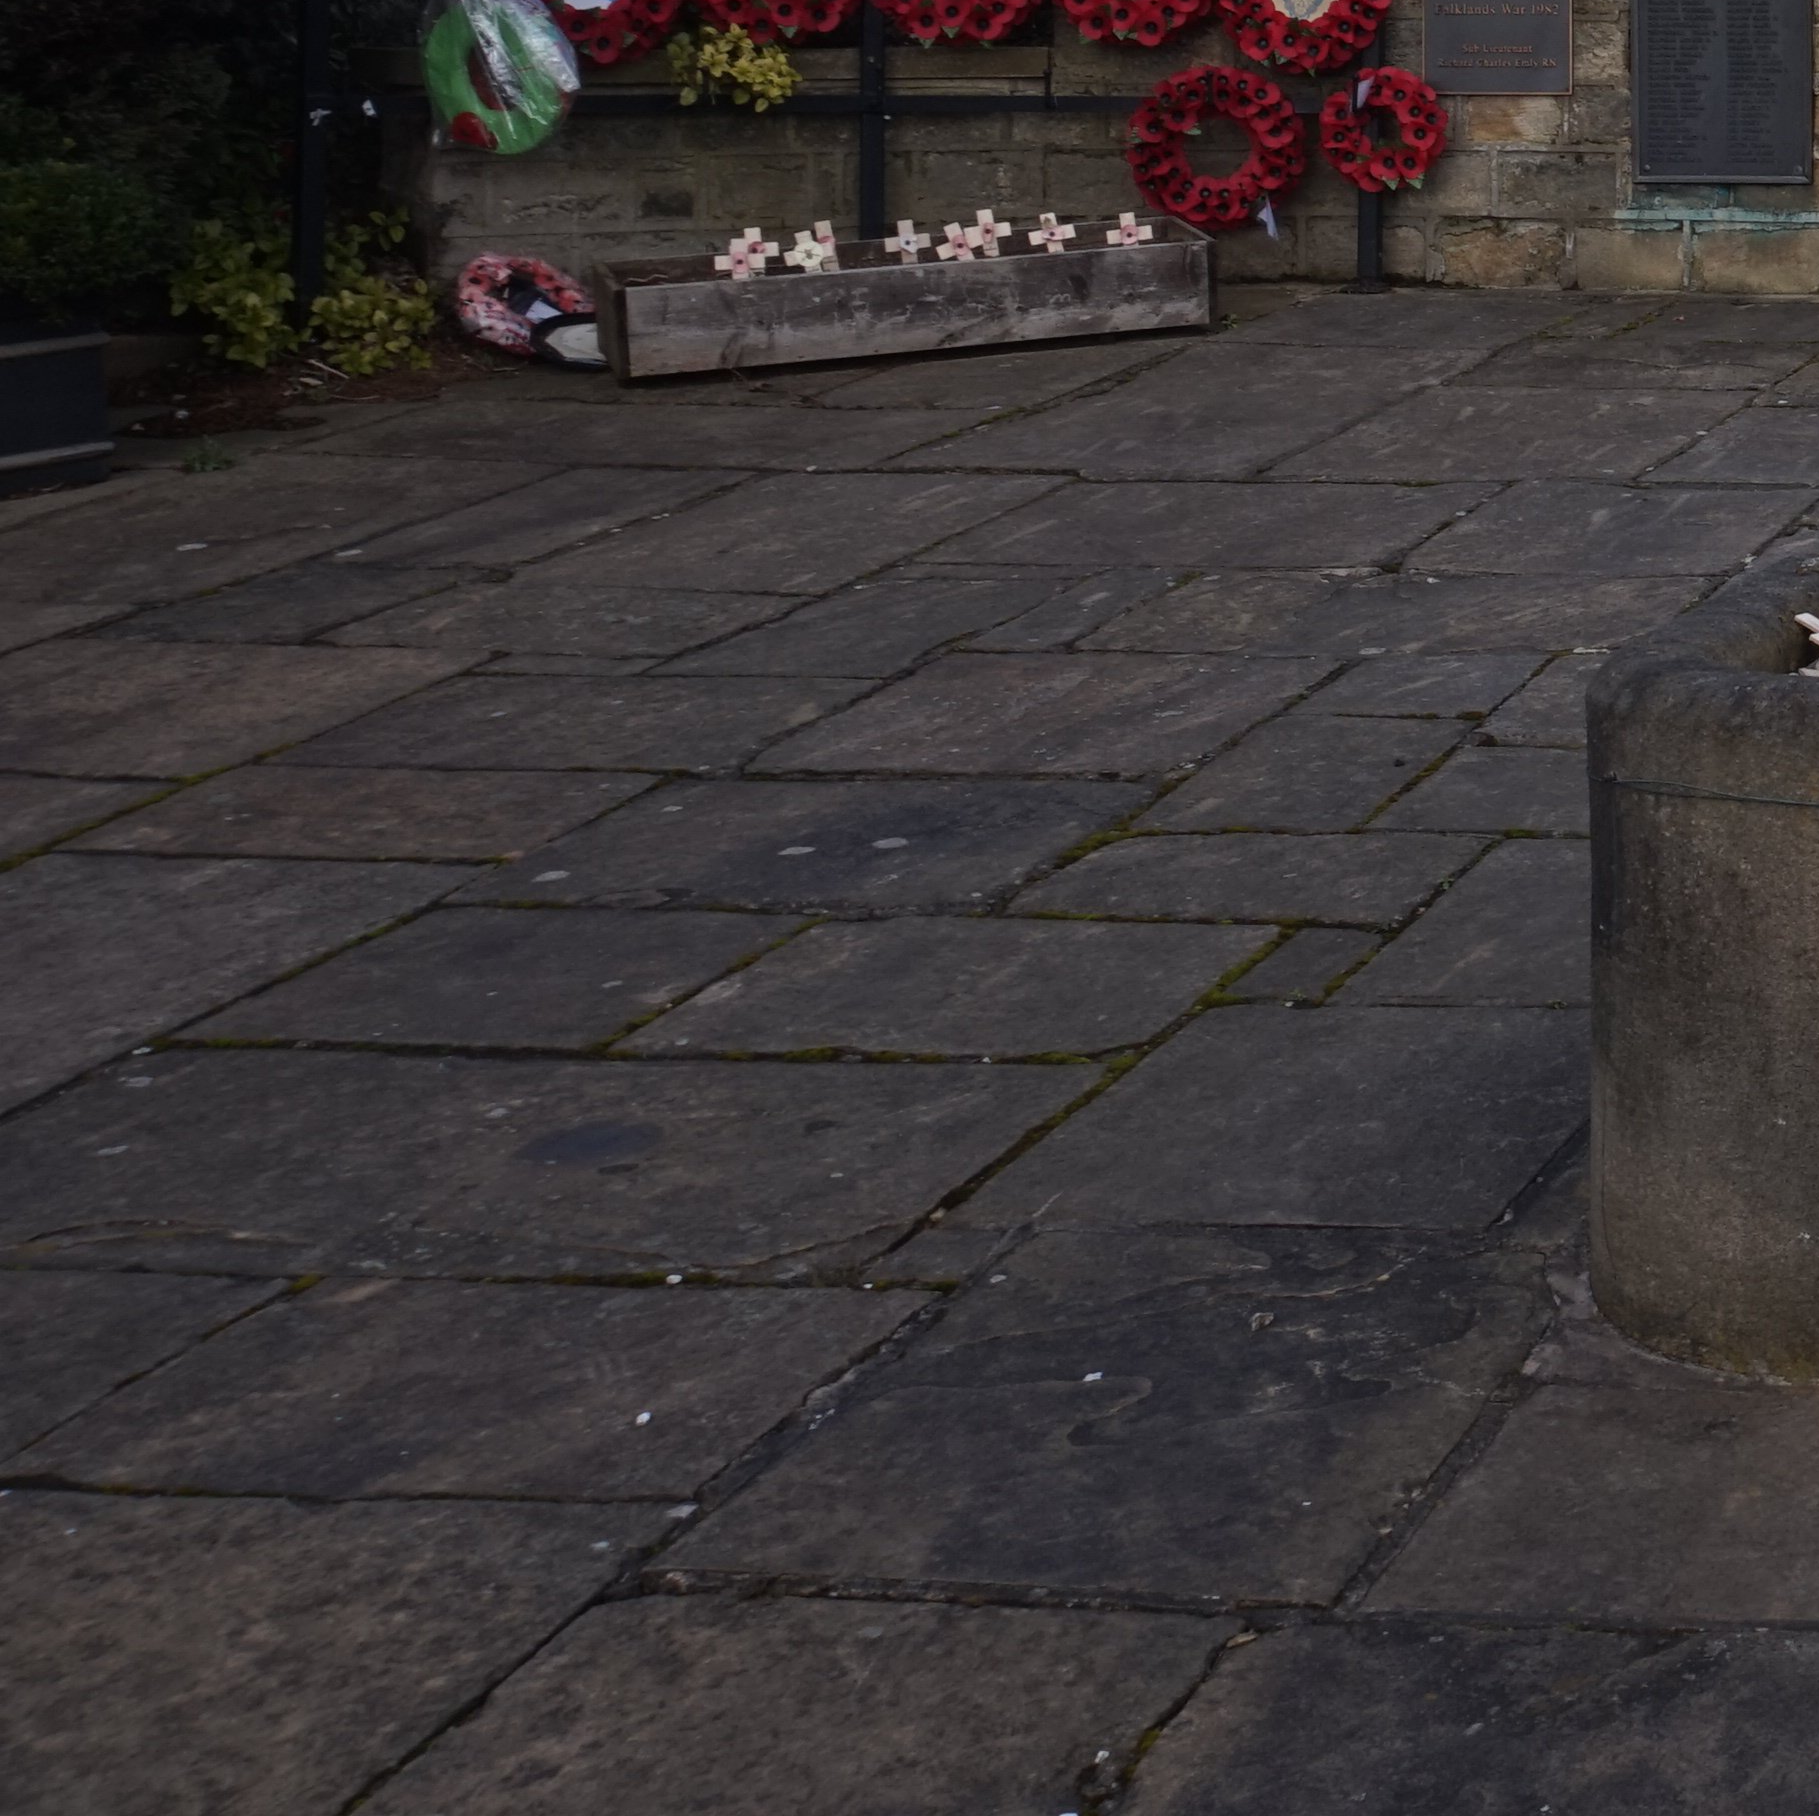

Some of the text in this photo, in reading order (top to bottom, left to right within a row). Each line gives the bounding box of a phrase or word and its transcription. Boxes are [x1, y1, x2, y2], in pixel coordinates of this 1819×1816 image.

[1434, 3, 1560, 16] Falklands War 1982
